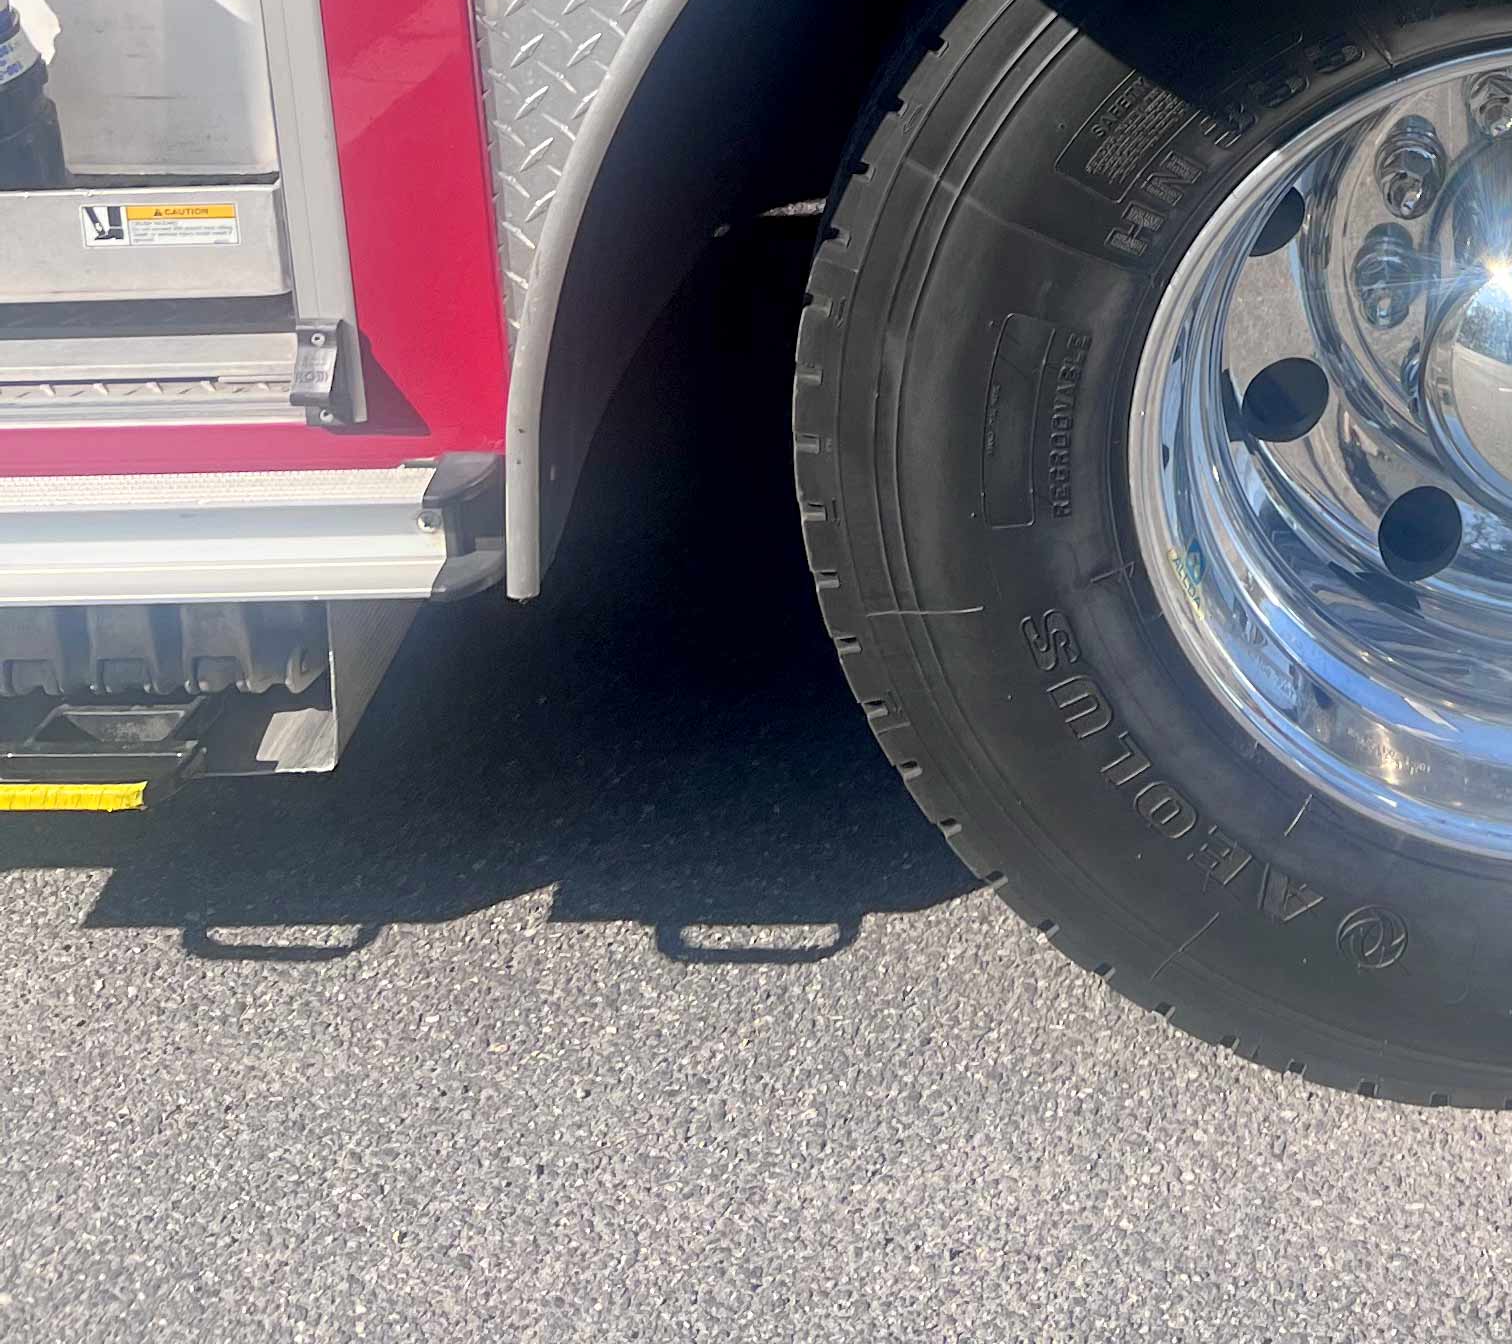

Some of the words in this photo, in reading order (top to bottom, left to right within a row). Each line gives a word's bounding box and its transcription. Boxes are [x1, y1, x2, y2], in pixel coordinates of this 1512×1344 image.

[1091, 75, 1148, 139] SAFETY
[164, 207, 209, 217] CAUTION
[1103, 149, 1202, 257] HN
[1050, 333, 1093, 518] REGROOVABLE
[1019, 609, 1326, 923] AEOLUS
